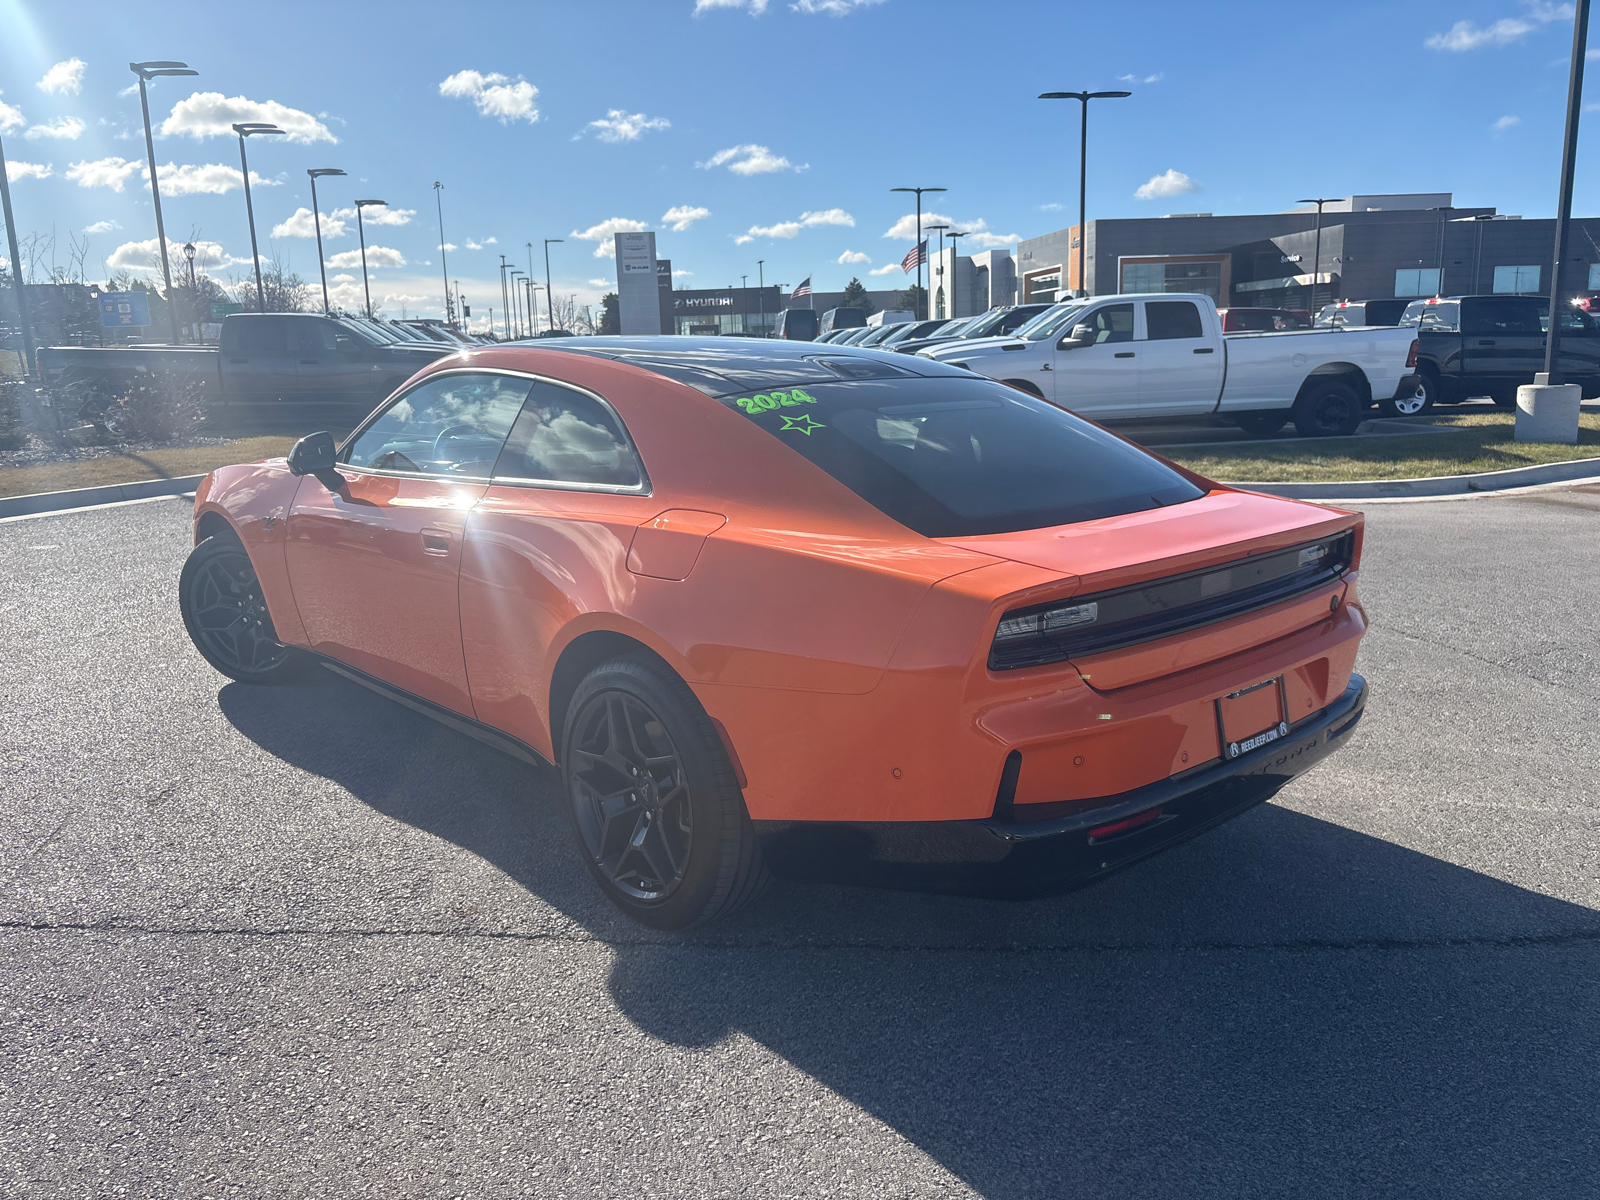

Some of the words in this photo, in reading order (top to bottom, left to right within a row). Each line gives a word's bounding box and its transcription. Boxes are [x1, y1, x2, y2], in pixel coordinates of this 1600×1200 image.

[686, 298, 733, 307] HYUNDAI
[736, 389, 818, 415] 2024
[1240, 729, 1278, 753] REEDJEEP.COM
